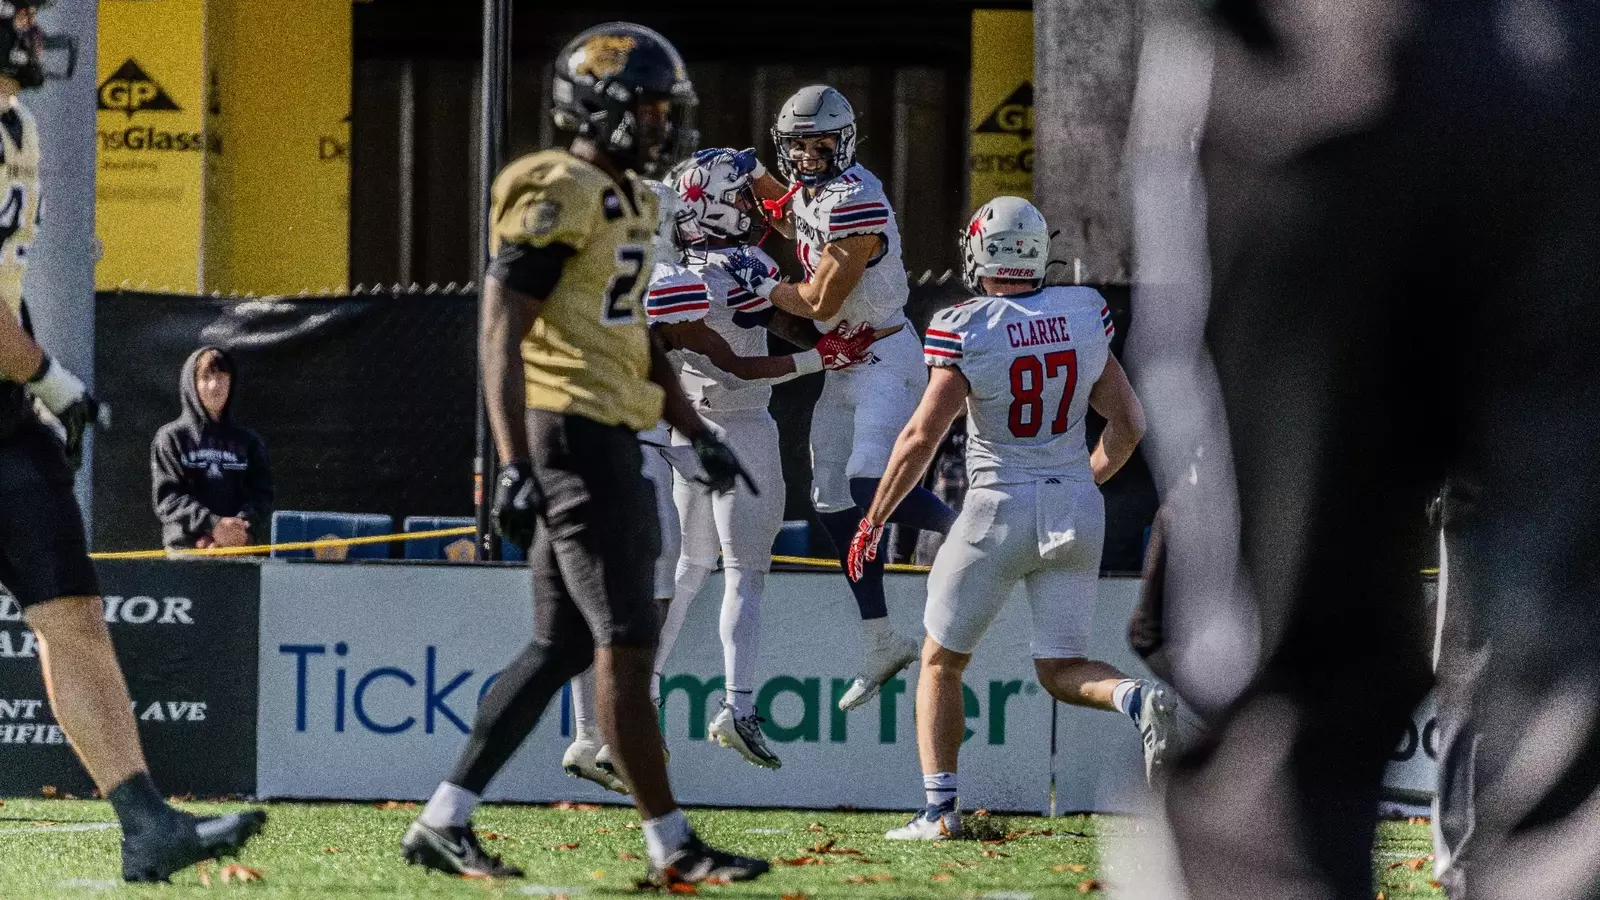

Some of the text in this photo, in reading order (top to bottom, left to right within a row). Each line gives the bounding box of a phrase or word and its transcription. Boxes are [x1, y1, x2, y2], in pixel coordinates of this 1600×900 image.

[996, 267, 1036, 278] SPIDERS
[1007, 316, 1071, 349] CLARKE
[1008, 350, 1078, 438] 87
[140, 701, 207, 721] AVE
